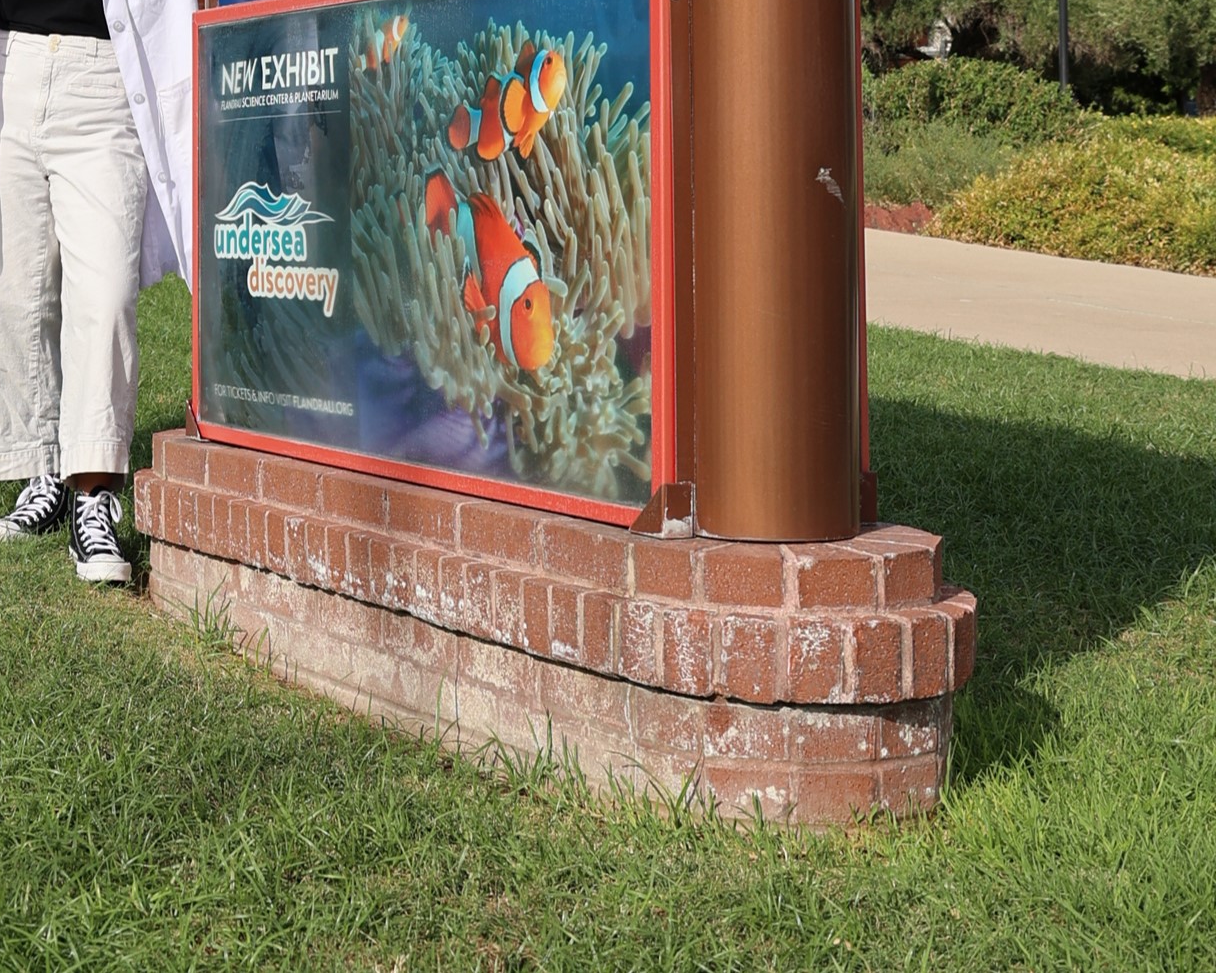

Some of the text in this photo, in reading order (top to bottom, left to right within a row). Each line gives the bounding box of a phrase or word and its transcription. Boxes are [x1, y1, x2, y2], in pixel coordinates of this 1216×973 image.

[221, 47, 339, 96] NEW EXHIBIT
[242, 94, 266, 108] SCIENCE
[266, 93, 289, 105] CENTER
[289, 94, 294, 104] &
[294, 89, 339, 104] PLANETARIUM
[214, 211, 306, 258] undersea
[248, 256, 337, 315] discovery
[214, 383, 354, 417] FOR TICKETS & INFO VISIT FLANDRAU.ORG
